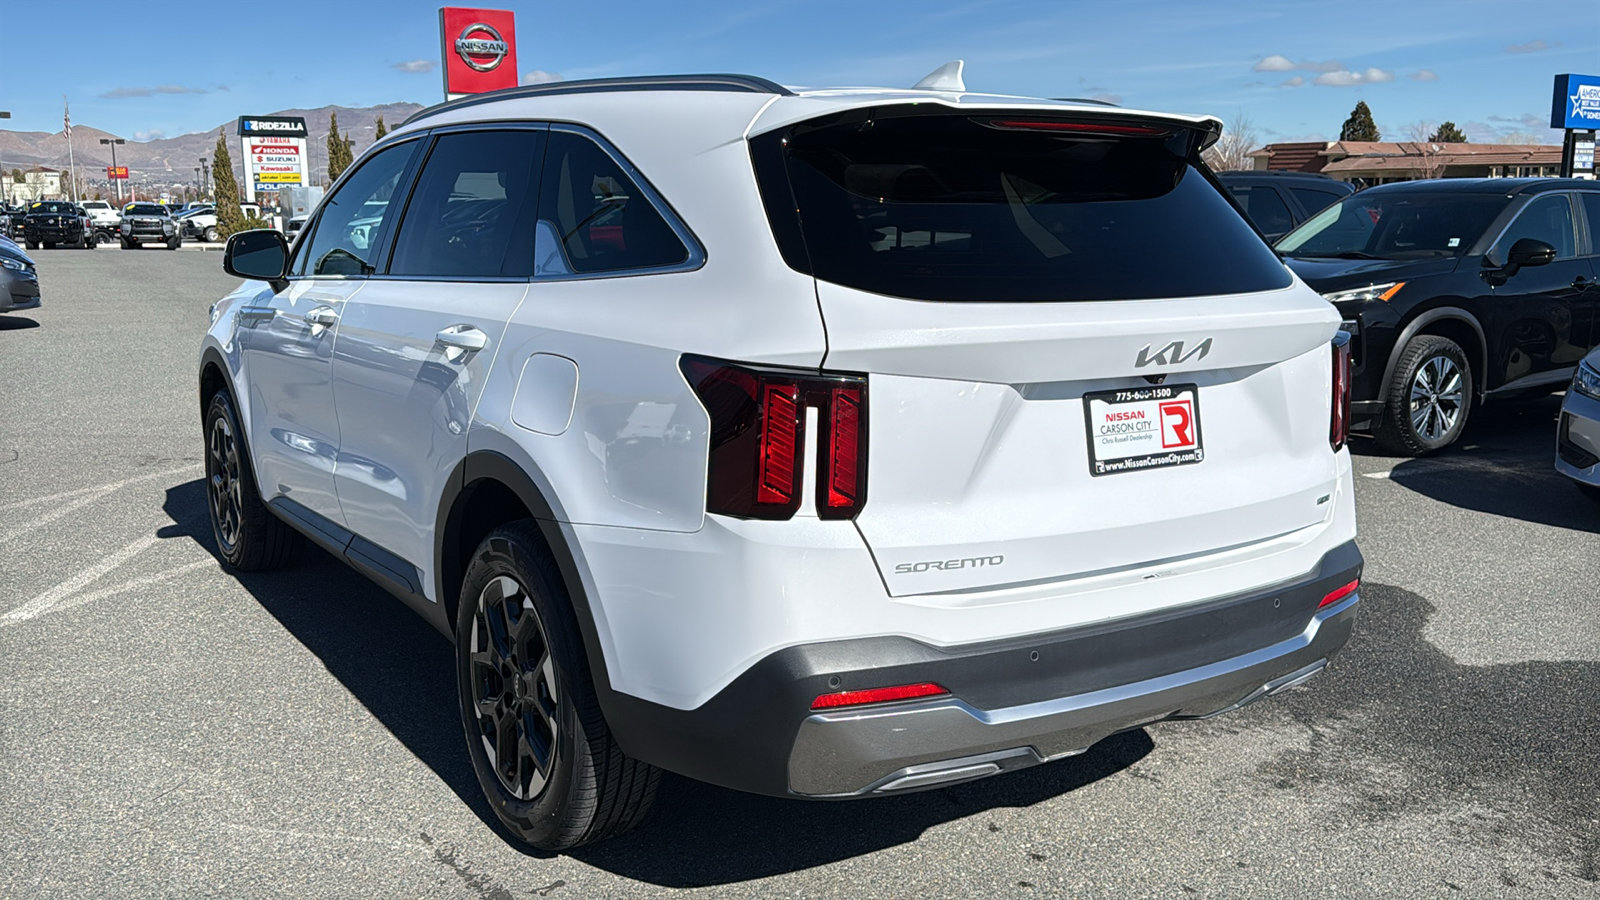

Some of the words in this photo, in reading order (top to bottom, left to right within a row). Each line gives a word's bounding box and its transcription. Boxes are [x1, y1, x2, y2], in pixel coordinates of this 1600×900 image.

[461, 42, 504, 51] NISSAN
[258, 121, 304, 131] RIDEZILLA
[1116, 388, 1172, 401] 775-600-1500
[1106, 410, 1145, 422] NISSAN
[1100, 422, 1134, 435] CARSON
[1135, 420, 1152, 431] CITY
[1101, 437, 1114, 445] Chris
[1114, 435, 1129, 443] Russell
[1129, 433, 1153, 442] Dealership
[1105, 453, 1195, 471] www.NissanCarsonCity.com
[895, 555, 1004, 574] SORENTO
